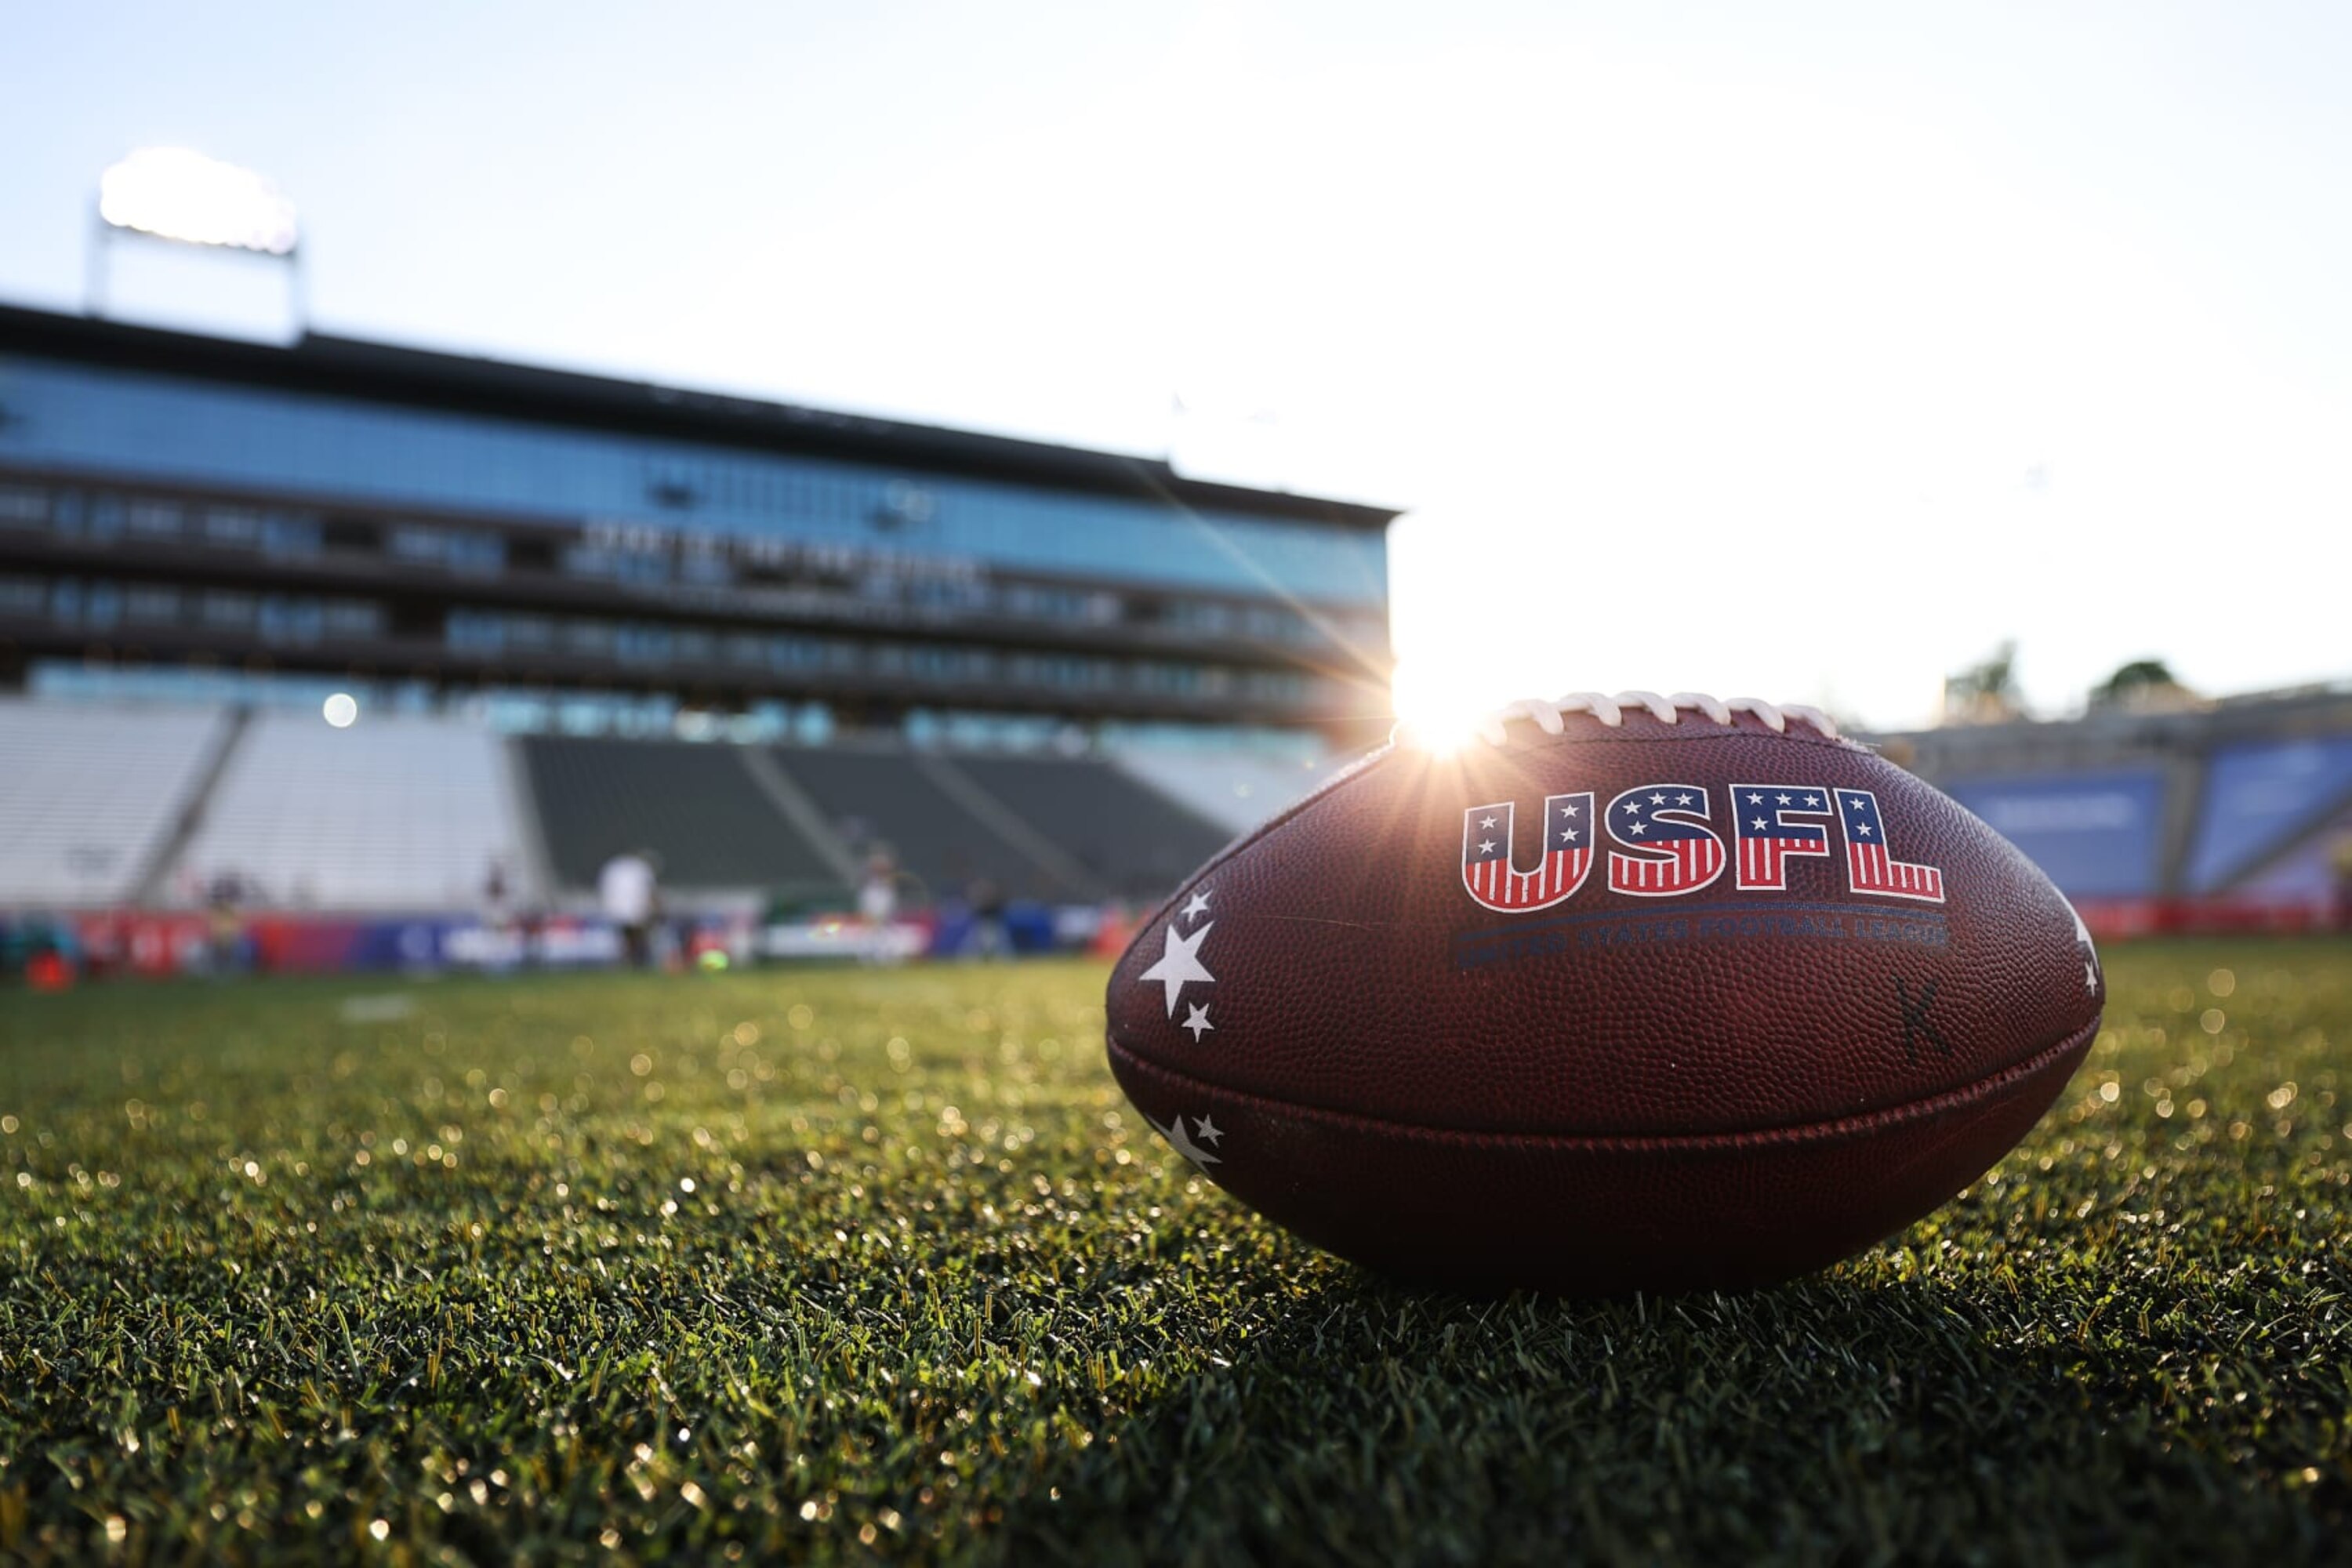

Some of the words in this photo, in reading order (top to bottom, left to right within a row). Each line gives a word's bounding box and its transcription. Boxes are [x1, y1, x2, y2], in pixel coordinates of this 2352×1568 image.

[1461, 783, 1946, 913] USFL
[1577, 920, 1688, 947] STATES
[1698, 916, 1846, 938] FOOTBALL
[1856, 920, 1949, 946] LEAGUE
[1893, 976, 1954, 1065] K
